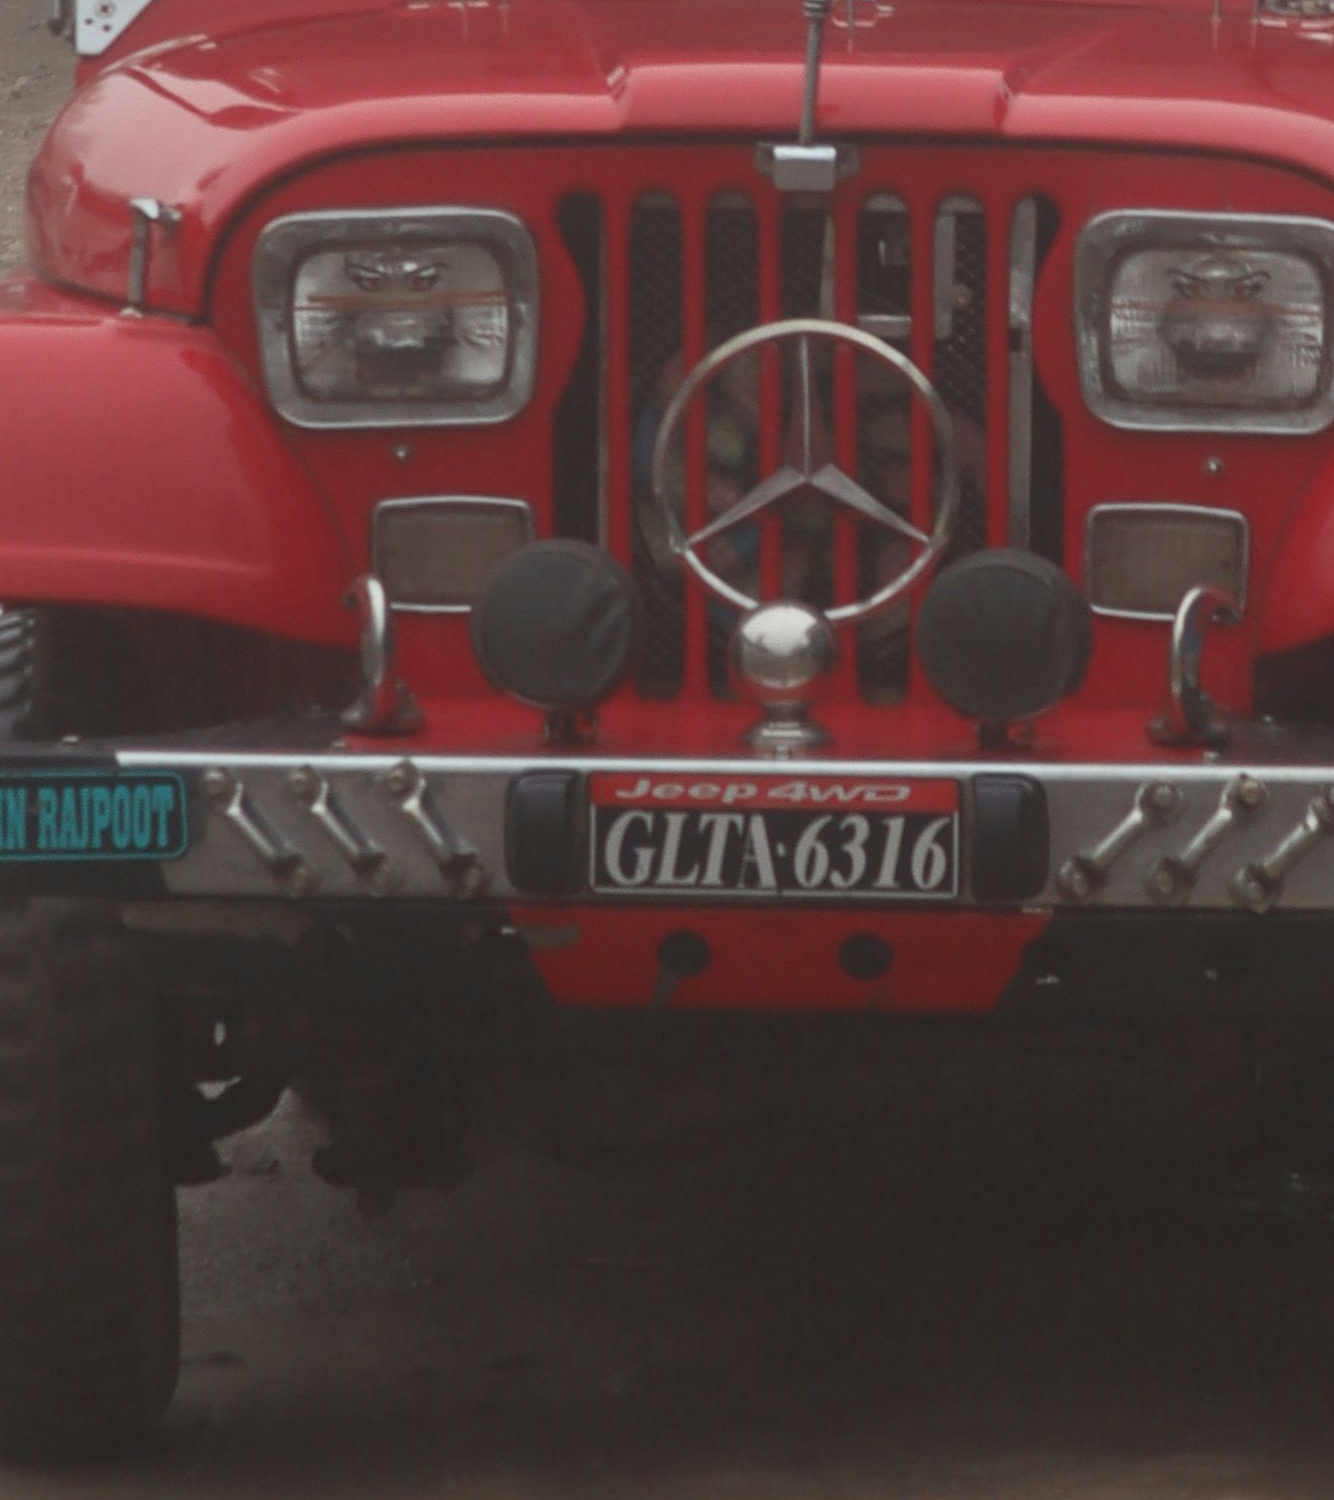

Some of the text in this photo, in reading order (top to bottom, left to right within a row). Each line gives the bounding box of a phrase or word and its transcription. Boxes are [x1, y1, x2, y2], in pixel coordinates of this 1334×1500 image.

[615, 779, 912, 804] Jeep 4WD
[36, 784, 175, 850] RAJPOOT
